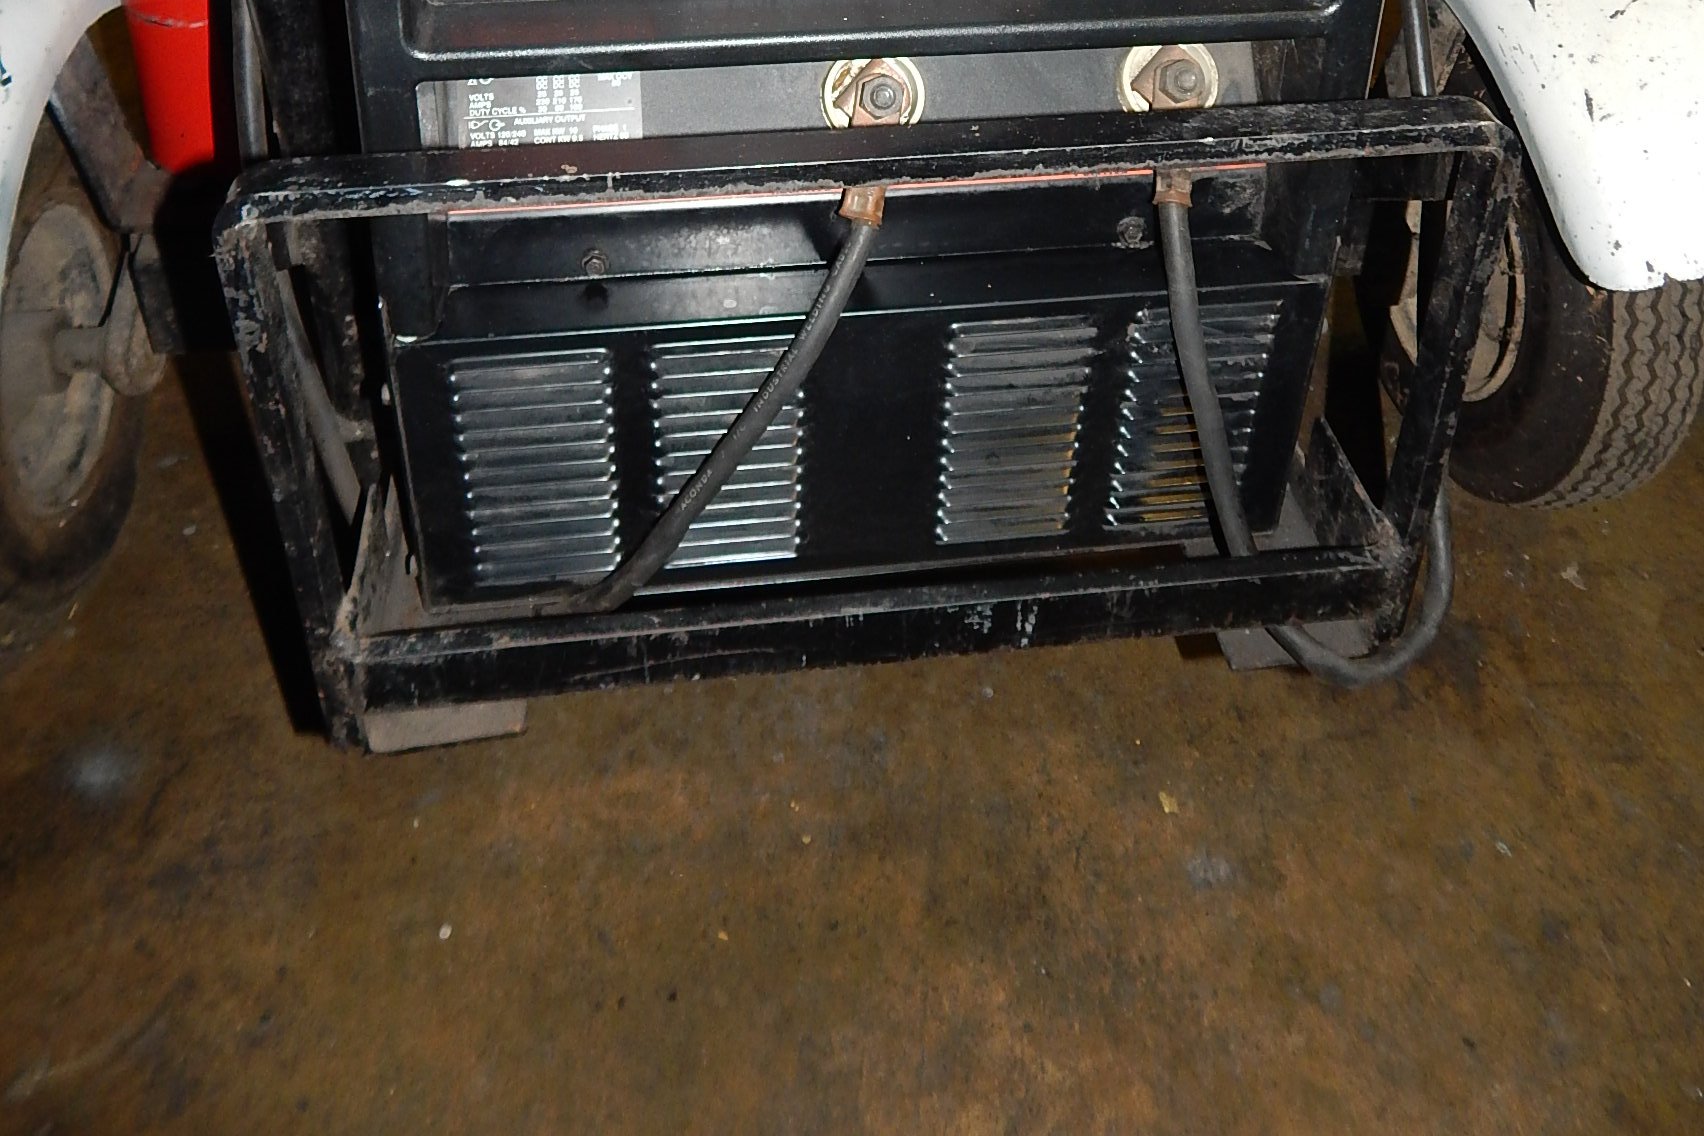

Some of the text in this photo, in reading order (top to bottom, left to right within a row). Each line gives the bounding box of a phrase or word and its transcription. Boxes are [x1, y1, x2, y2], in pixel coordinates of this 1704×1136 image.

[469, 108, 490, 117] DUTY
[491, 107, 517, 116] CYCLE
[753, 348, 799, 413] INDUSTRIAL
